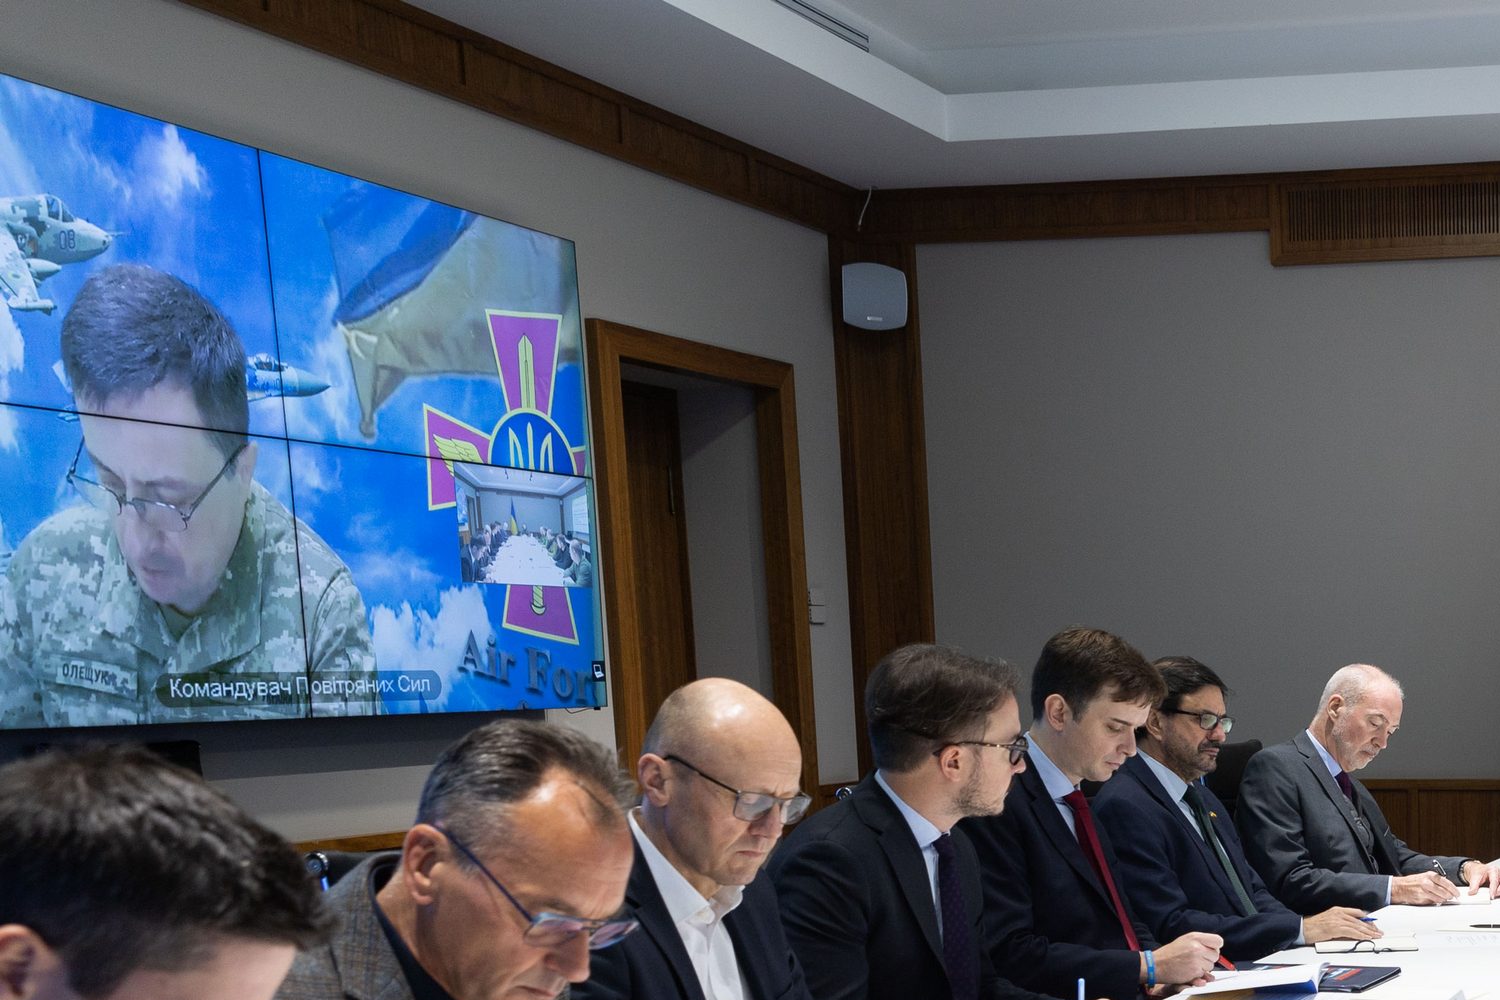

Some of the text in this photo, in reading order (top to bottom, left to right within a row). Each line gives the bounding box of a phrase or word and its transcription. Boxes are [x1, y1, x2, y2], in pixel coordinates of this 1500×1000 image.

[169, 678, 292, 702] Командувач
[295, 676, 394, 698] Повітряних
[397, 675, 430, 692] Сил
[458, 630, 597, 705] Air For
